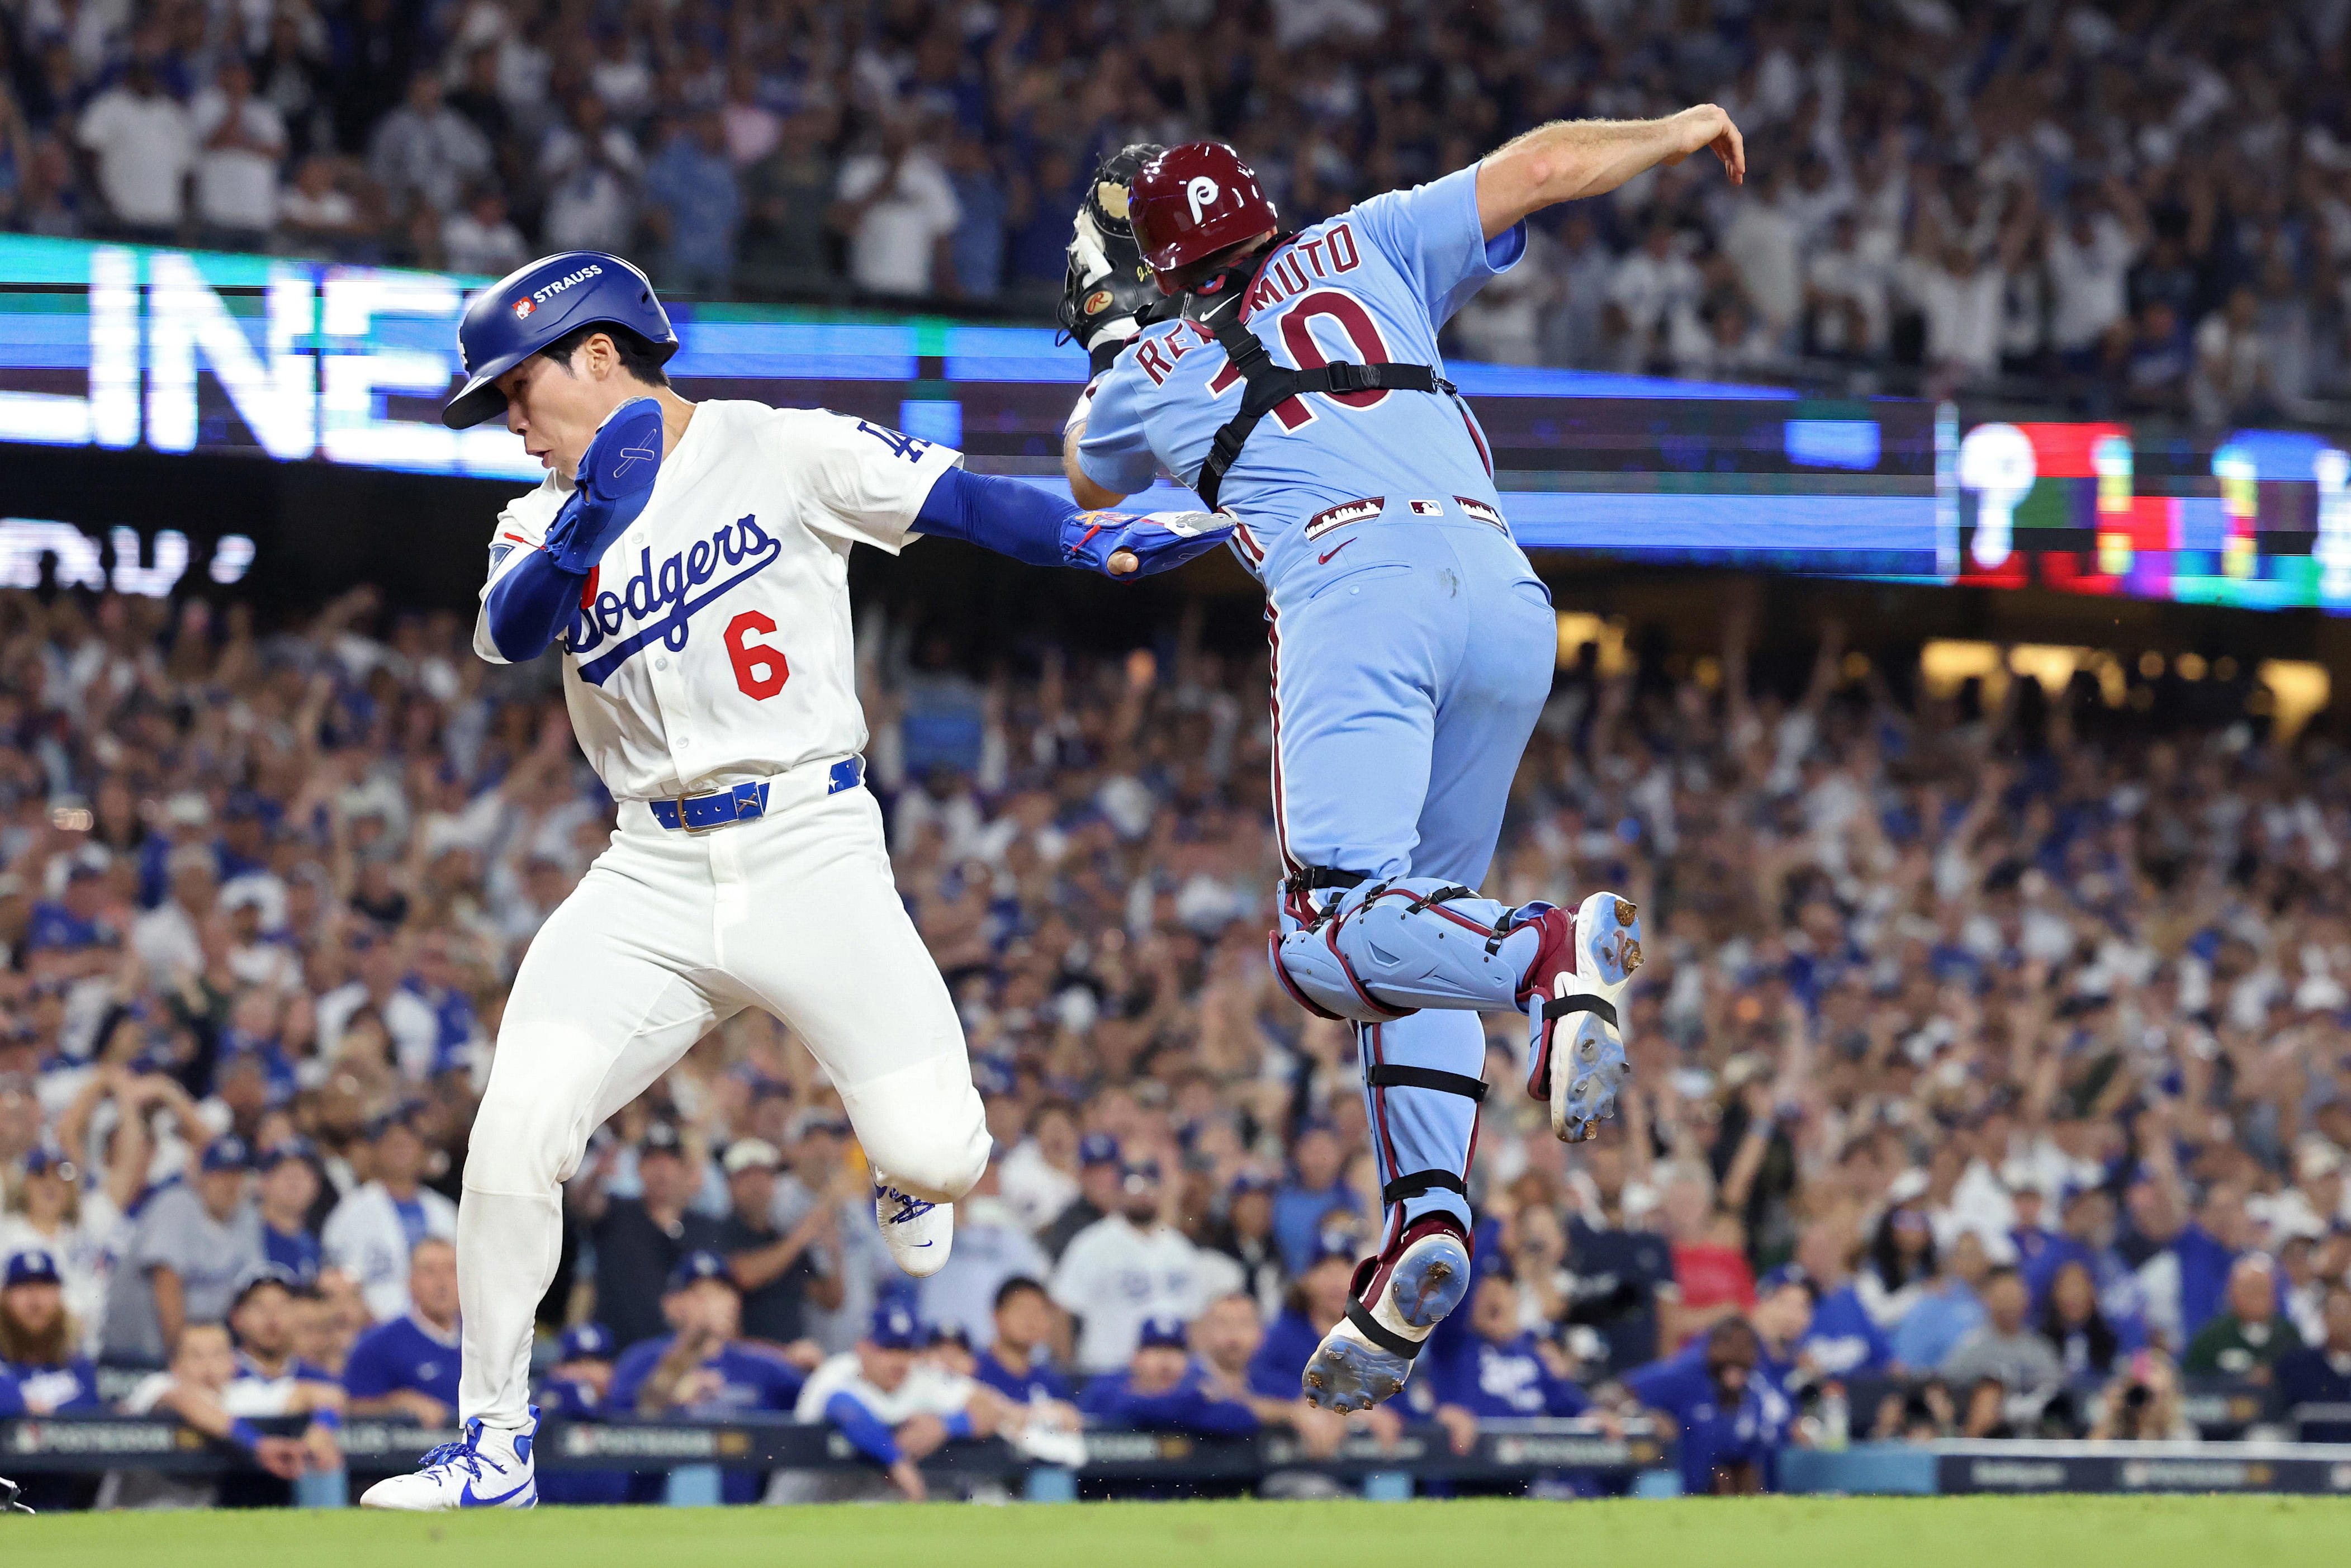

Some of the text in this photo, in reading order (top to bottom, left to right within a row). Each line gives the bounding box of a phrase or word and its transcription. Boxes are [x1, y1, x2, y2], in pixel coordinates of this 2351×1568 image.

[1186, 176, 1219, 225] P
[533, 264, 603, 304] STRAUSS
[1134, 221, 1362, 390] REMUTO
[1205, 286, 1395, 435] 10
[857, 420, 932, 463] LA
[723, 610, 789, 701] 6
